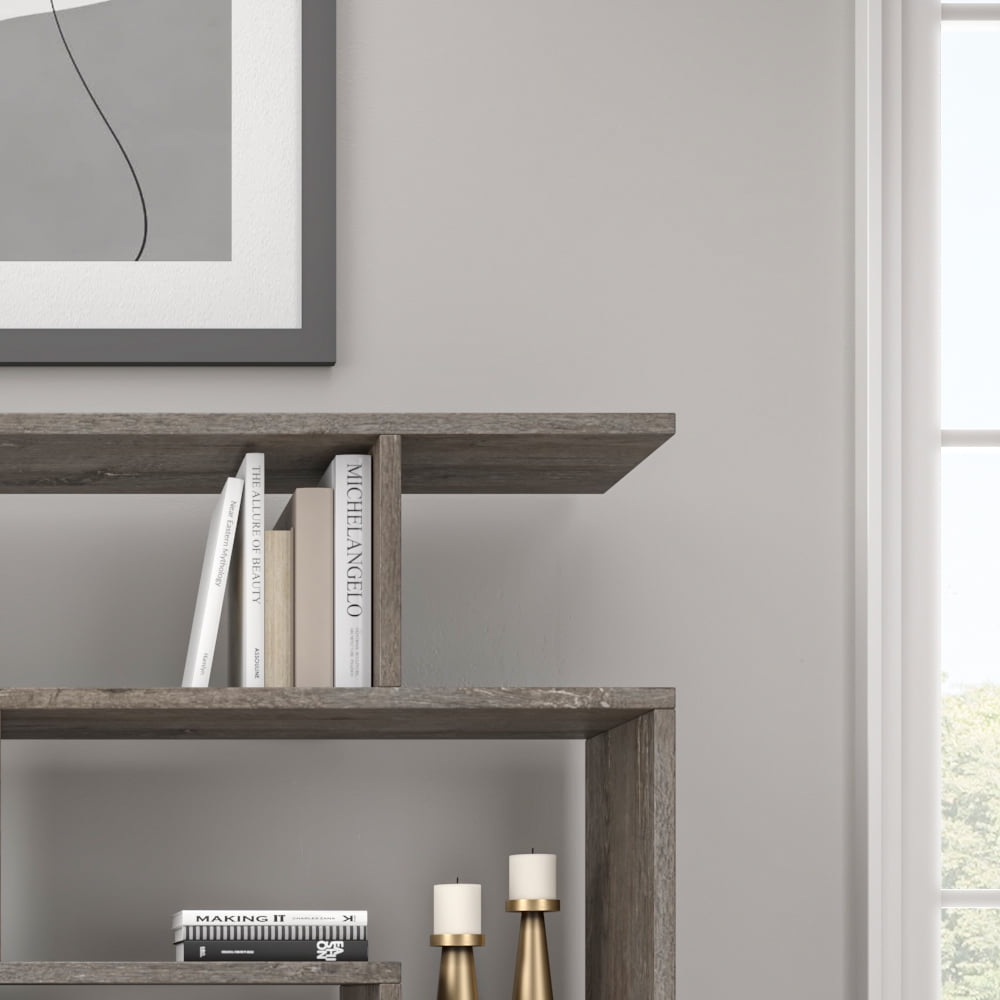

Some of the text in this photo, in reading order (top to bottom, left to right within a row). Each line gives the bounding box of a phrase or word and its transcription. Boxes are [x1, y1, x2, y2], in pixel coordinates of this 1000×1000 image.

[215, 501, 237, 588] Near Eastern Mythology
[251, 465, 261, 605] THE ALLURE OF BEAUTY
[346, 464, 363, 618] MICHELANGELO
[196, 914, 286, 923] MAKING IT
